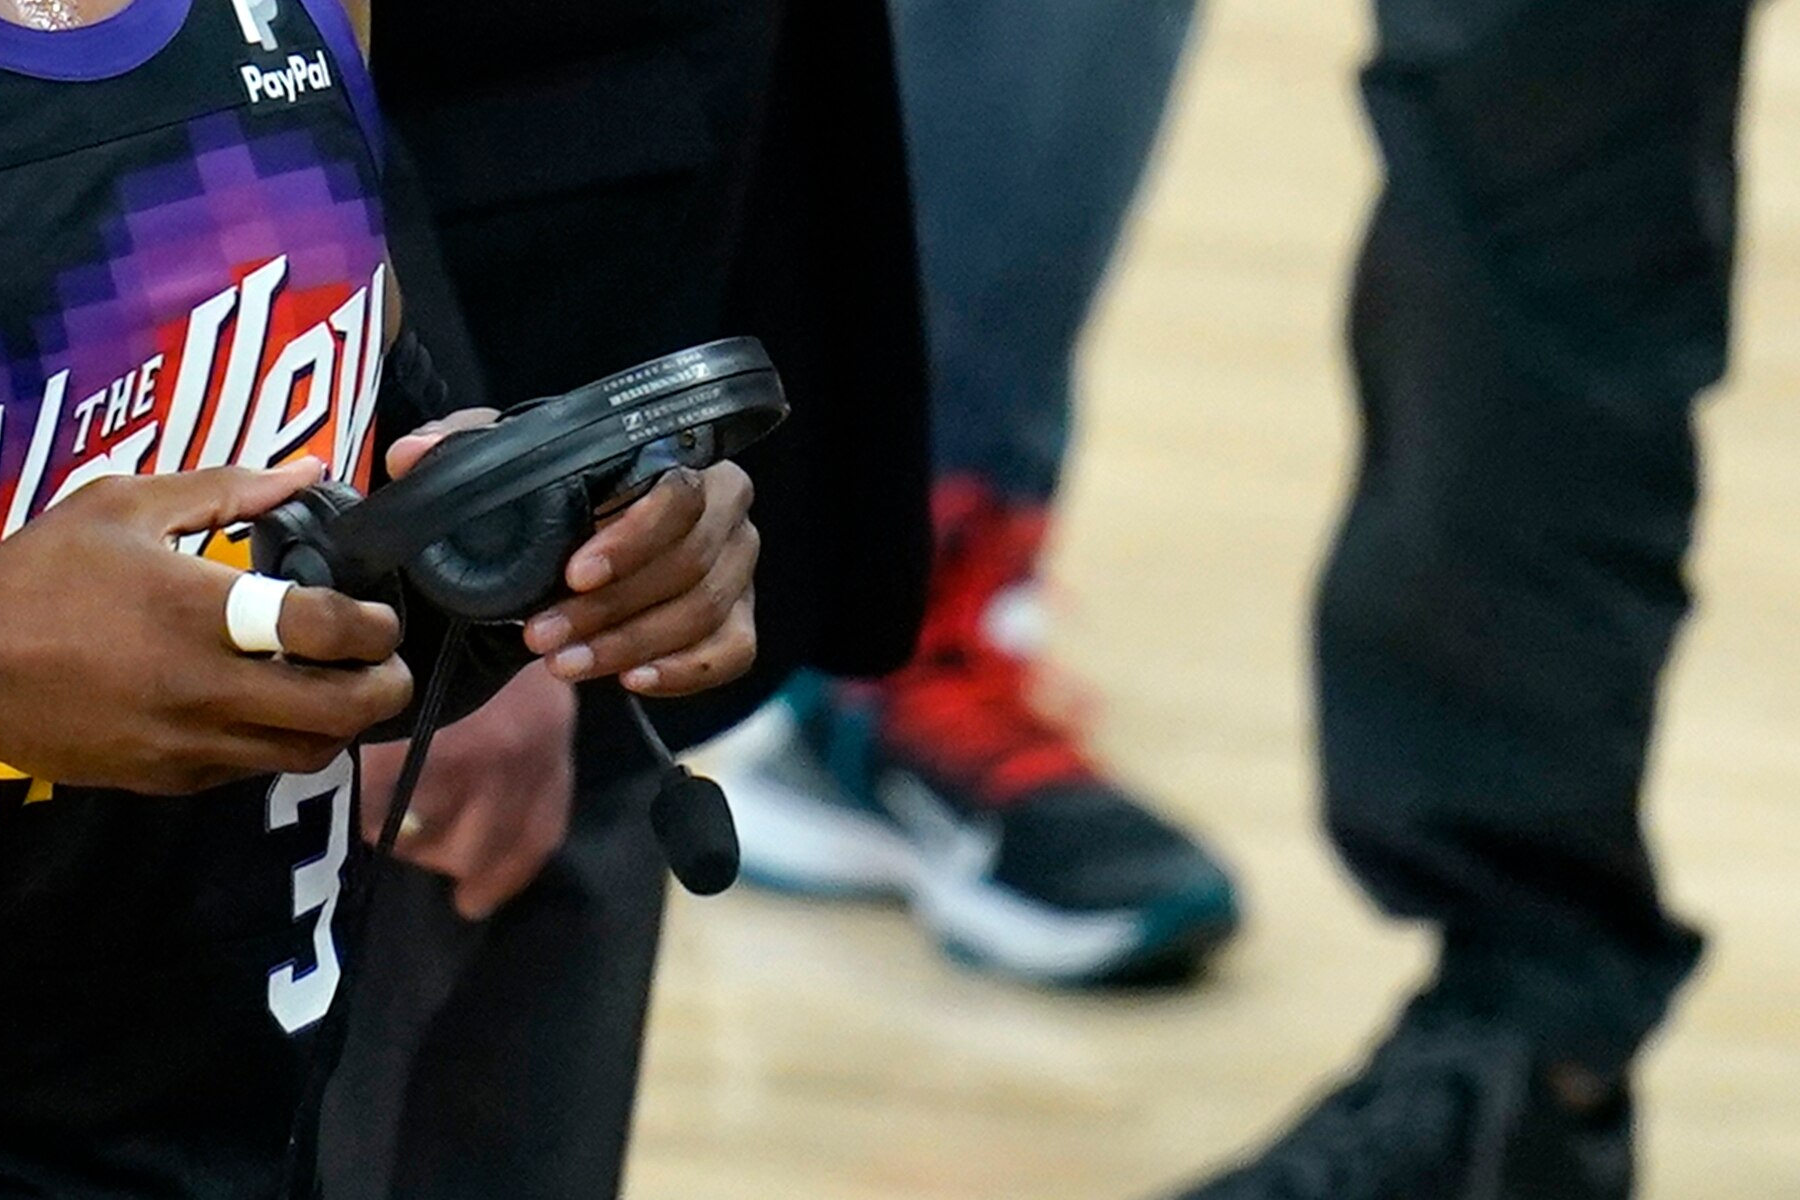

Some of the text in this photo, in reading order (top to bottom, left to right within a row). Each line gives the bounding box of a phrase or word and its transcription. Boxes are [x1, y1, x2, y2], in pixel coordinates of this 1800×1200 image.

[240, 49, 332, 103] PayPal
[73, 354, 163, 454] THE
[266, 746, 354, 1035] 3
